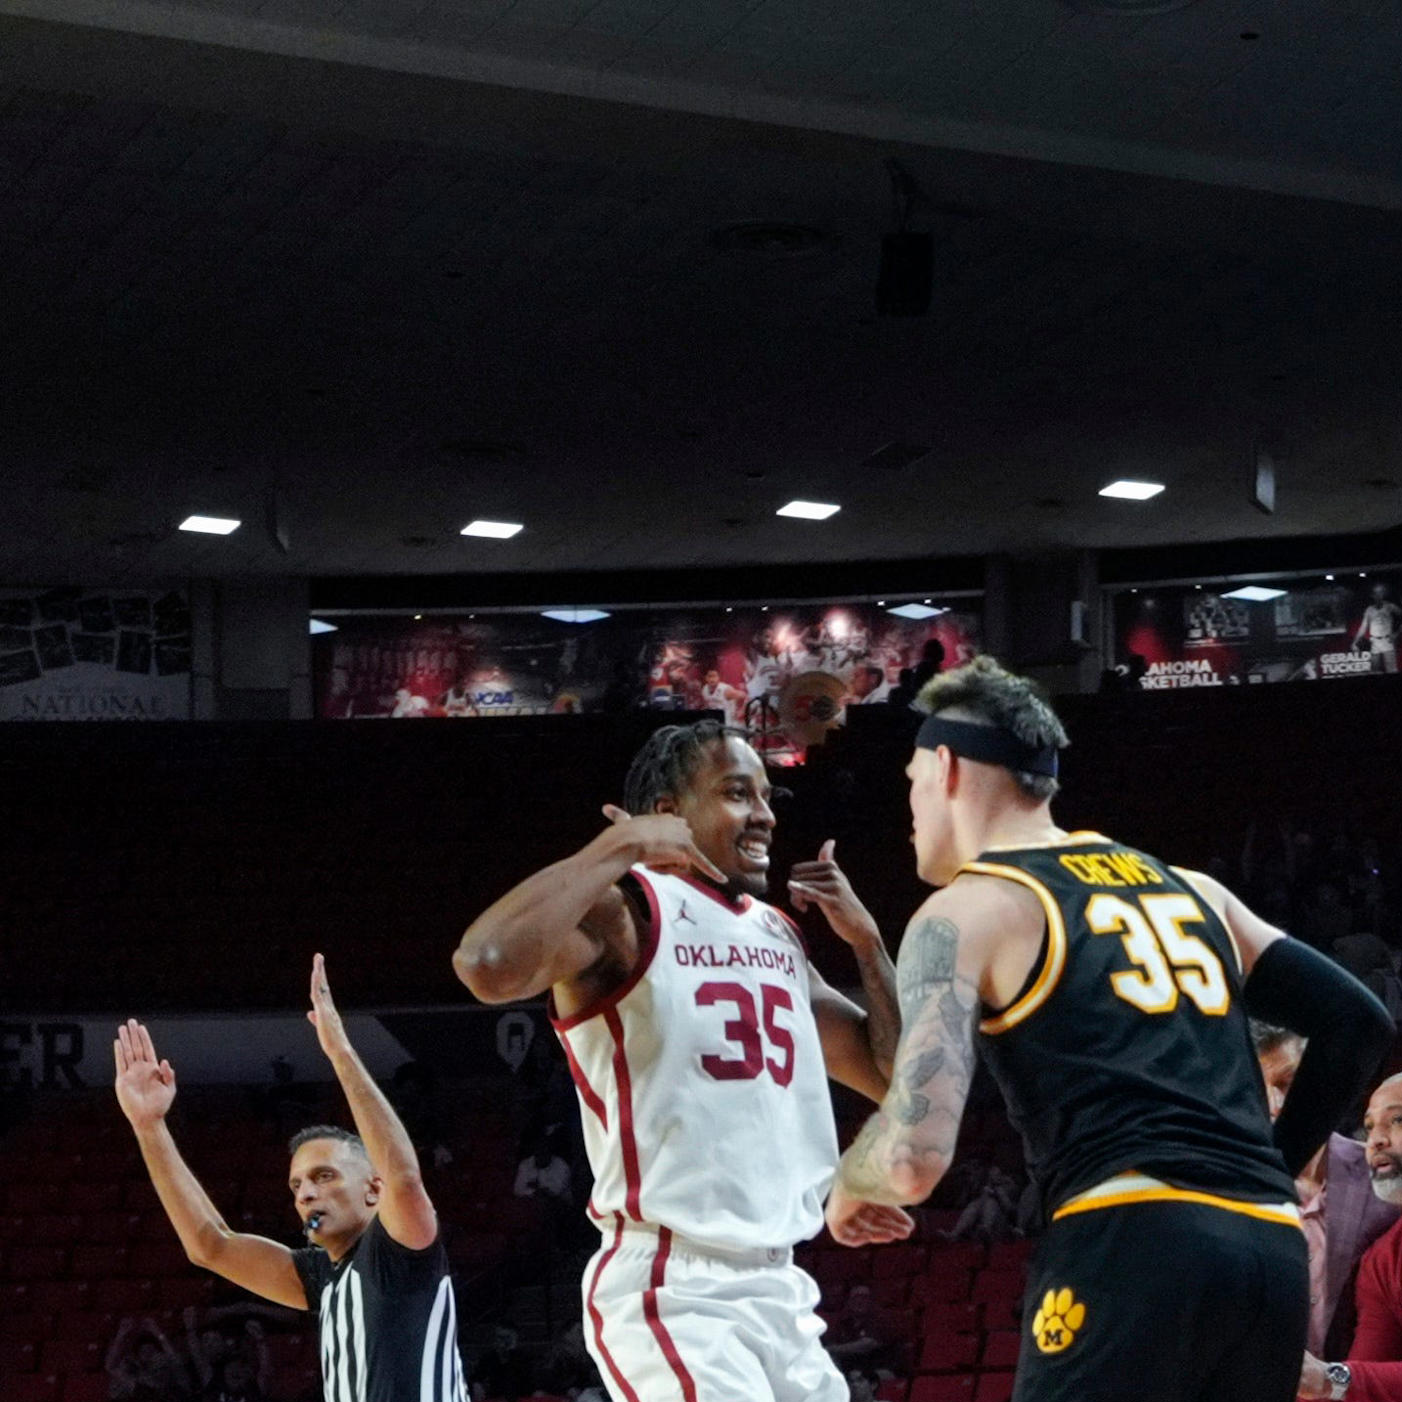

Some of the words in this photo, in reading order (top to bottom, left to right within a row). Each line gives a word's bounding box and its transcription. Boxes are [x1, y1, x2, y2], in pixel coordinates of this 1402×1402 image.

[1146, 659, 1212, 676] AHOMA
[1320, 651, 1372, 665] GERALD
[1321, 661, 1372, 674] TUCKER
[1059, 852, 1163, 887] CREWS
[675, 944, 797, 979] OKLAHOMA
[1084, 892, 1231, 1016] 35
[694, 981, 795, 1089] 35
[0, 1022, 87, 1089] ER
